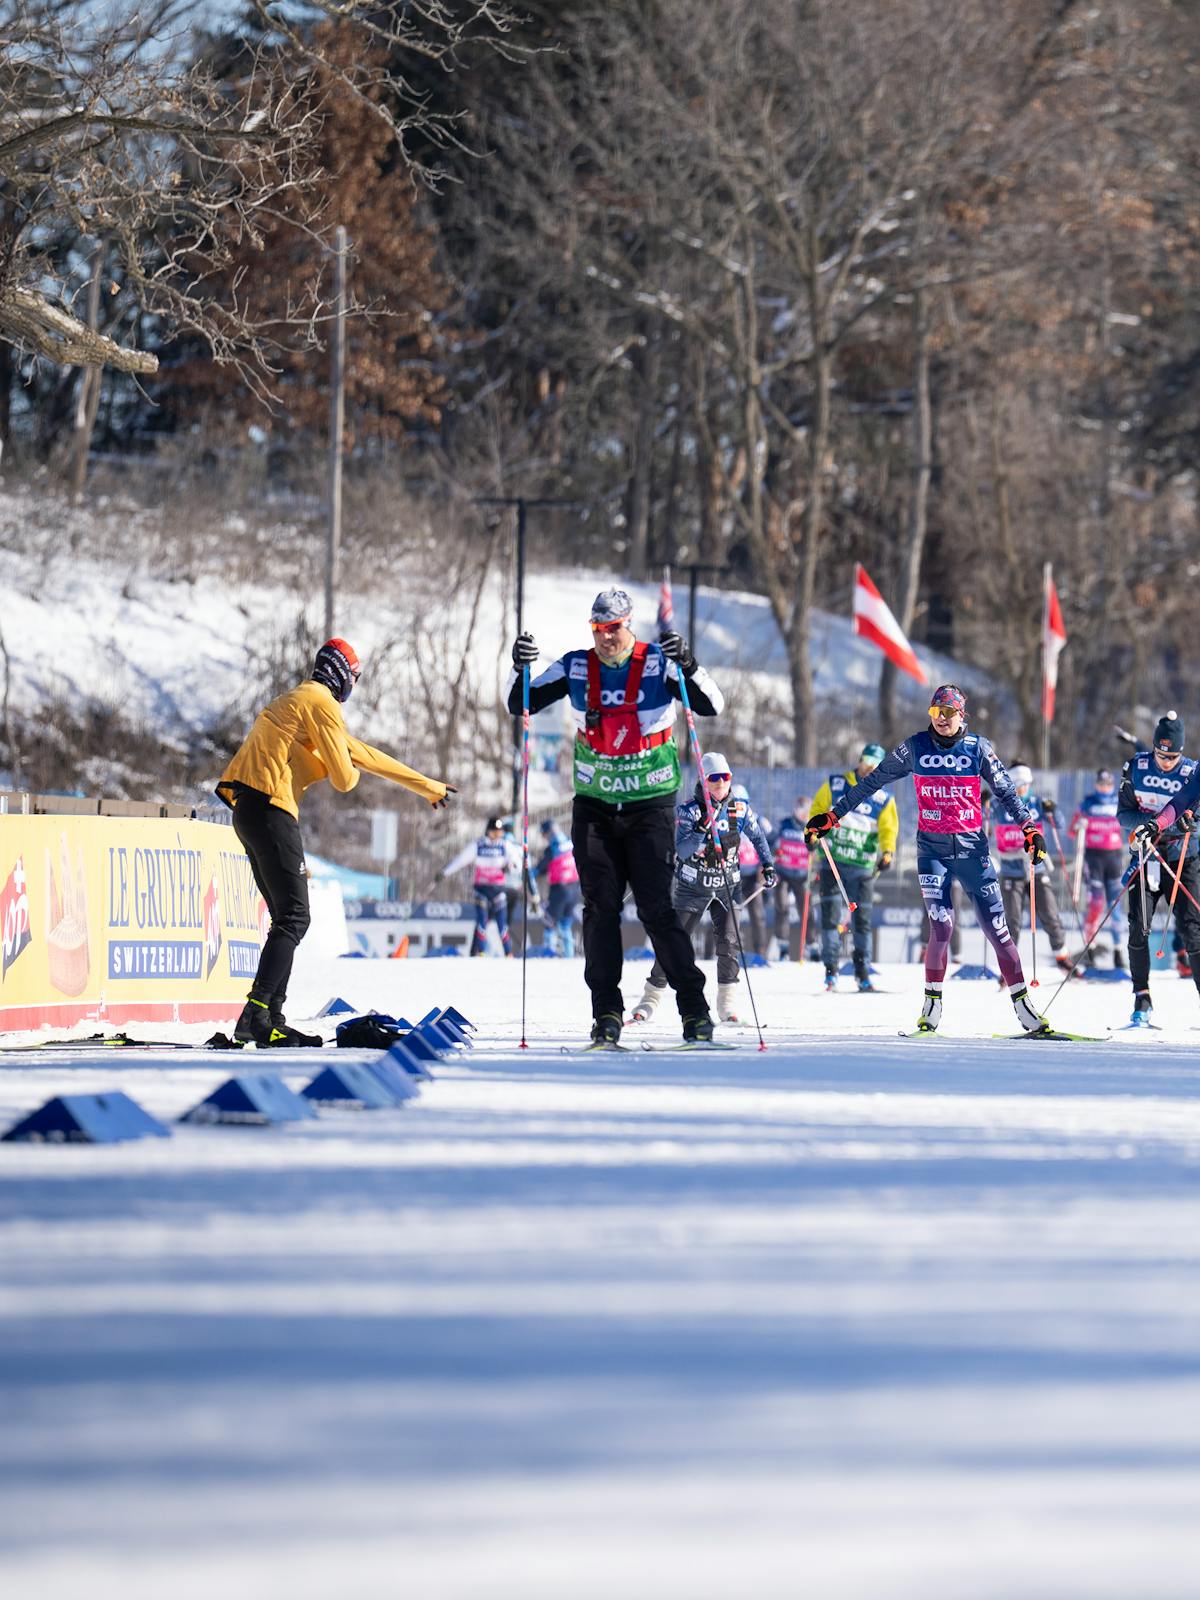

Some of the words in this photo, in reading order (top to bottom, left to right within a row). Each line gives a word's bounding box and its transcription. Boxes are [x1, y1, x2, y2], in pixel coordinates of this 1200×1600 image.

[919, 754, 972, 771] coop
[599, 775, 640, 793] CAN
[921, 786, 973, 798] ATHLETE
[1143, 775, 1182, 793] coop
[109, 847, 129, 928] LE
[134, 832, 203, 929] GRUYÈRE
[113, 946, 200, 974] SWITZERLAND
